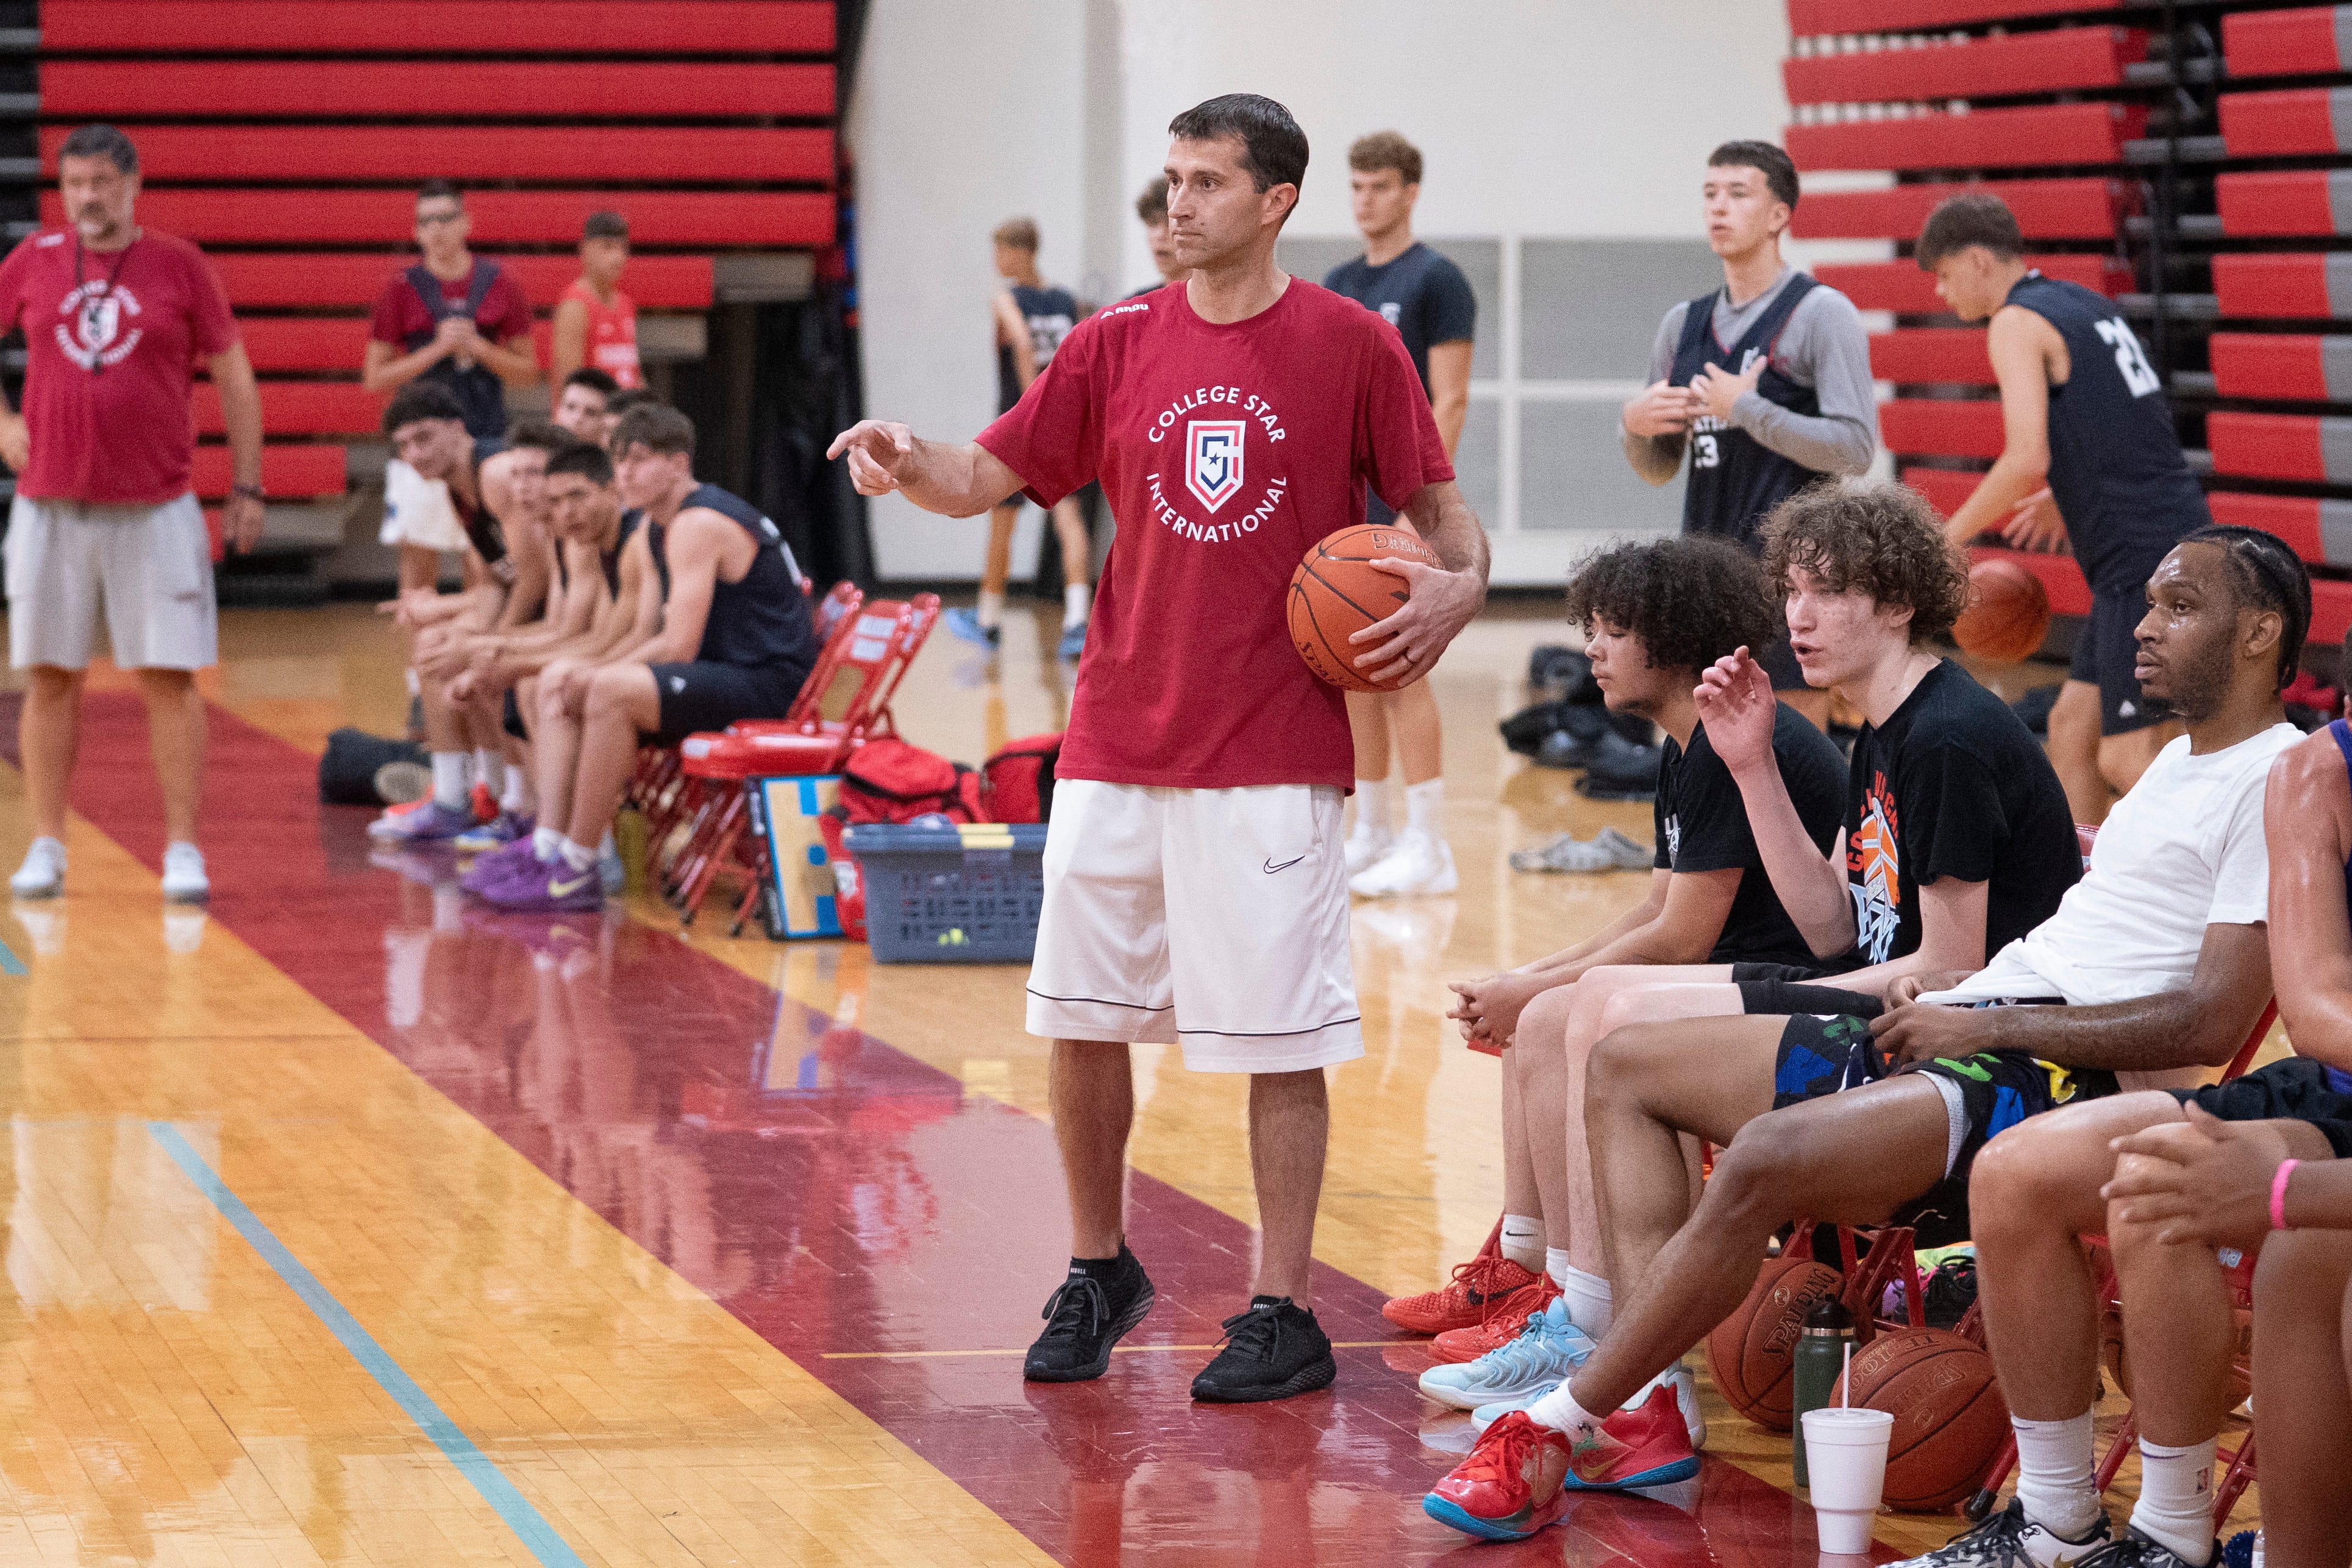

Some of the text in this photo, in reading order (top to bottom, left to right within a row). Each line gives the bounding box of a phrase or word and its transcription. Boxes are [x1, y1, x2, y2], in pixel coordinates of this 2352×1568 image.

[1149, 385, 1285, 443] COLLEGE STAR
[1147, 473, 1287, 543] INTERNATIONAL
